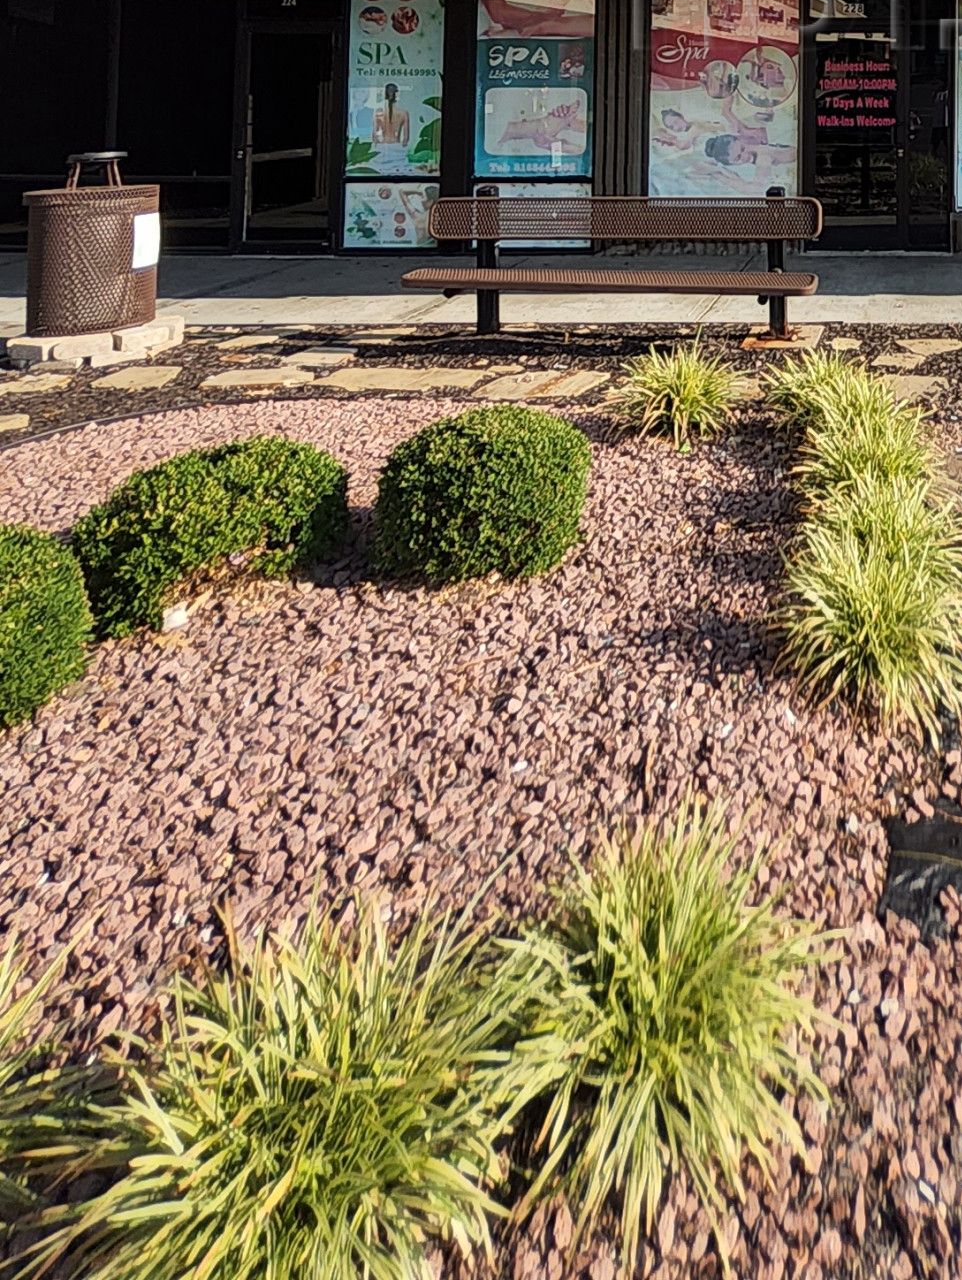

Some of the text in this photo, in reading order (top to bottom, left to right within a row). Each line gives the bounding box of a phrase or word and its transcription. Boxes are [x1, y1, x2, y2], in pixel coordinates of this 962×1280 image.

[844, 4, 864, 13] 228
[357, 42, 407, 65] SPA
[489, 45, 550, 67] SPA
[656, 34, 710, 69] Spa
[825, 60, 864, 71] Business
[357, 68, 376, 77] Tel:
[833, 97, 854, 110] Days
[856, 98, 863, 108] A
[865, 97, 889, 108] Week
